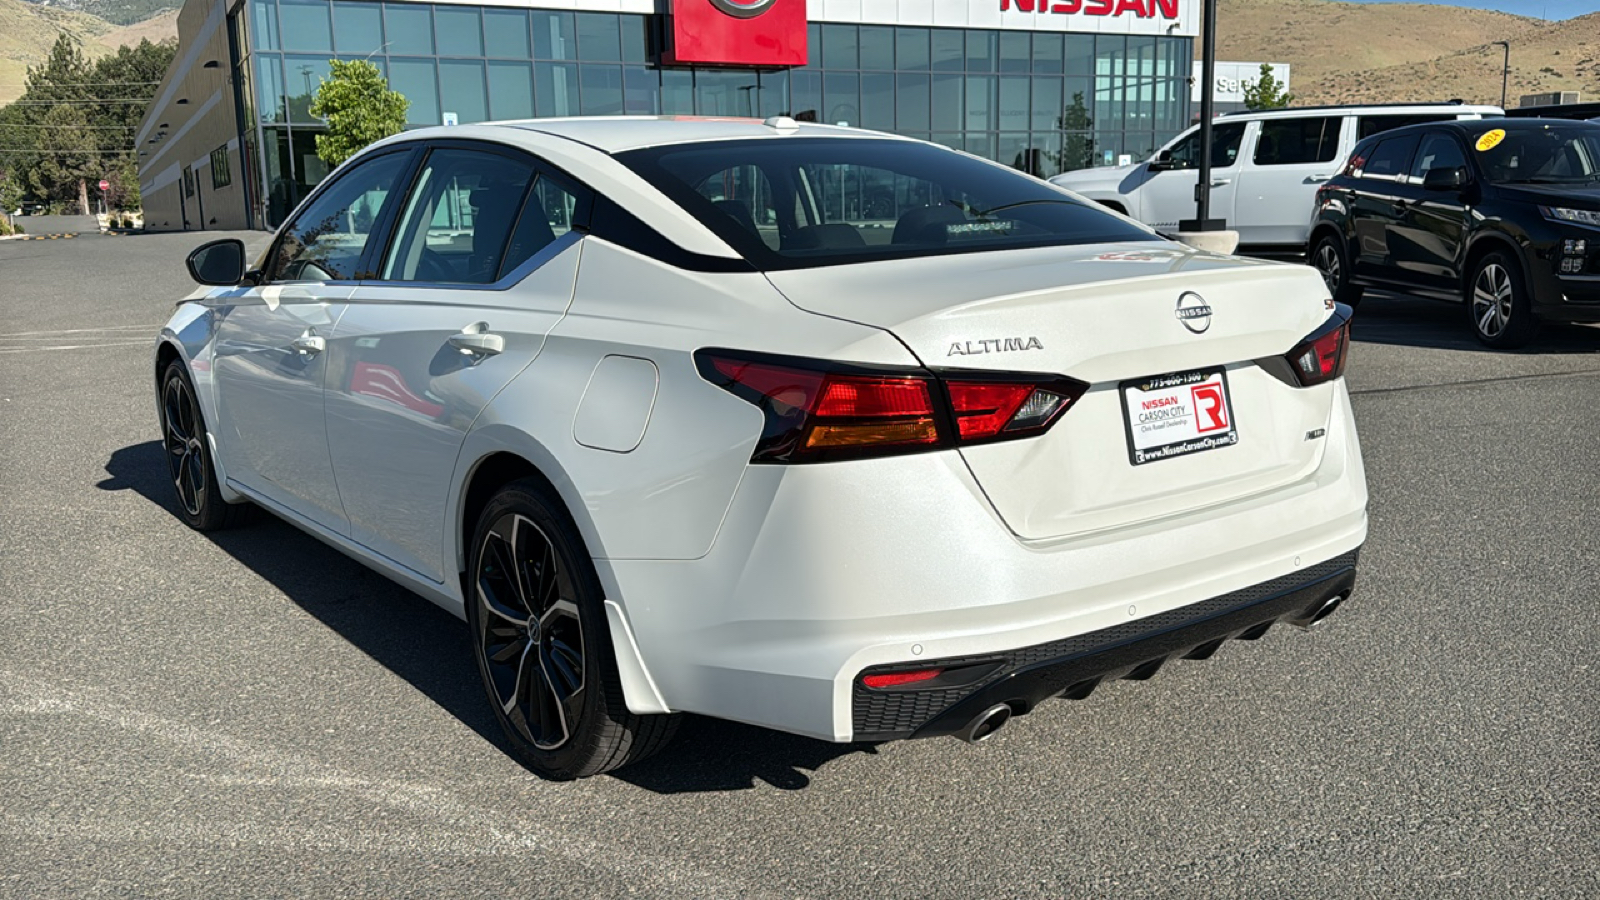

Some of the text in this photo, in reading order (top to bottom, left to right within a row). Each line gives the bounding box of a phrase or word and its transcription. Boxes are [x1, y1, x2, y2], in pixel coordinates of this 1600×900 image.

[947, 336, 1044, 356] ALTIMA
[1142, 396, 1178, 410] NISSAN
[1139, 405, 1185, 423] CARSON CITY
